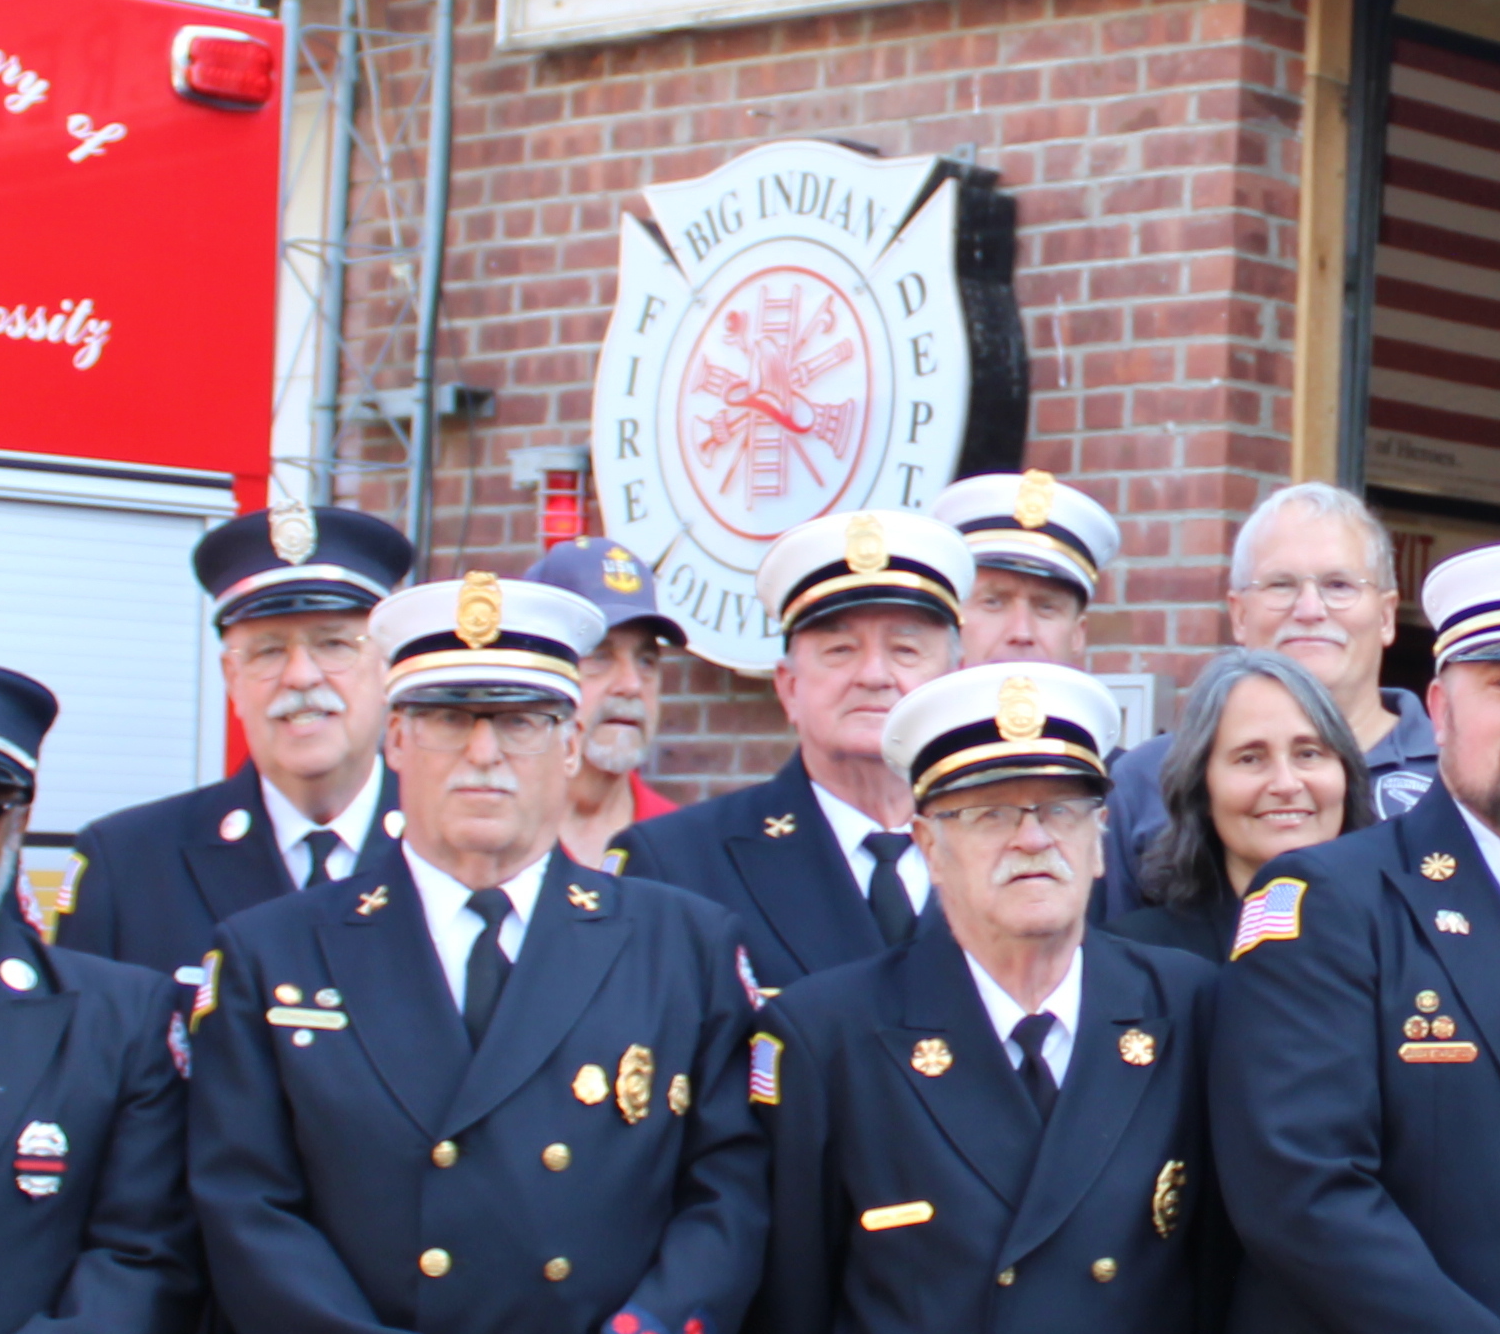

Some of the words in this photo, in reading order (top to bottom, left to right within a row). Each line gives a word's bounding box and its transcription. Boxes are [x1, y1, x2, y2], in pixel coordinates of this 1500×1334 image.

[66, 113, 128, 163] of
[683, 191, 744, 261] BIG
[756, 170, 888, 247] INDIAN
[617, 294, 666, 525] FIRE
[895, 271, 939, 509] DEPT.
[1390, 529, 1436, 601] XIT
